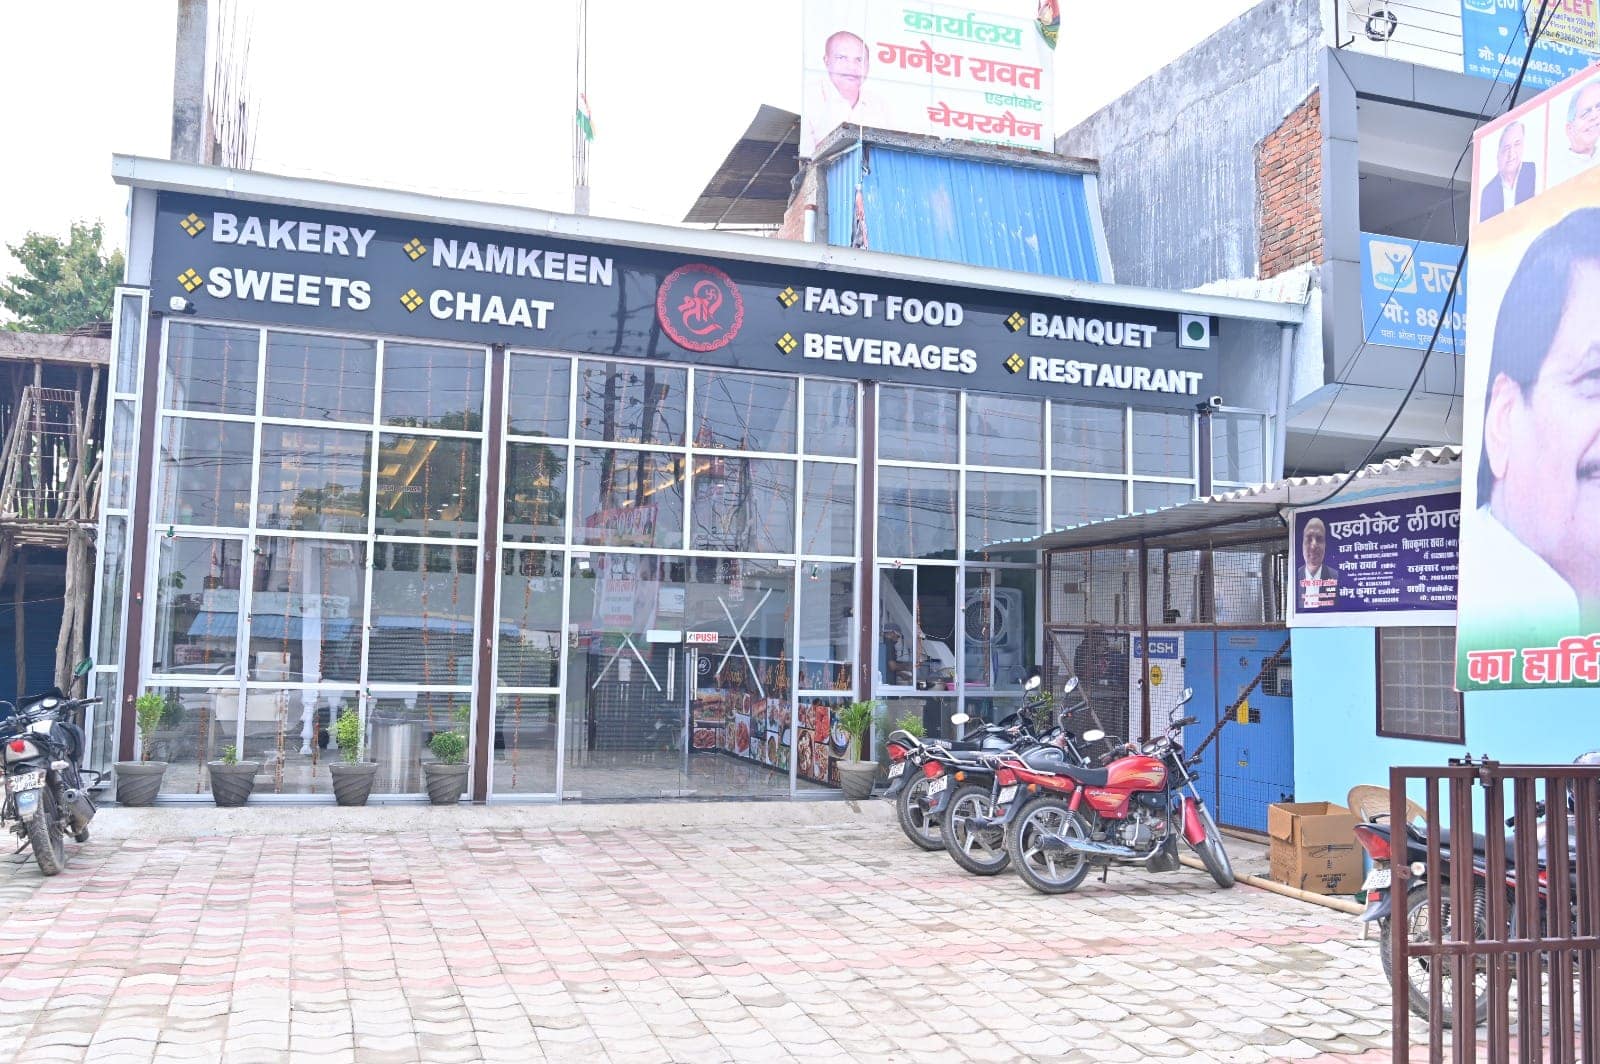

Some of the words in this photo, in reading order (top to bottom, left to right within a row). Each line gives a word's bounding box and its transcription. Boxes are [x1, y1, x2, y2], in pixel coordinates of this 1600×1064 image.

[903, 9, 1023, 46] कार्यालय
[876, 40, 963, 78] गनेश
[968, 57, 1043, 90] रावत
[927, 101, 1043, 140] चेयरमैन
[211, 212, 376, 258] BAKERY
[432, 238, 614, 286] NAMKEEN
[206, 266, 371, 311] SWEETS
[803, 285, 878, 319] FAST
[886, 295, 964, 328] FOOD
[429, 289, 555, 330] CHAAT
[1029, 313, 1157, 349] BANQUET
[803, 332, 978, 375] BEVERAGES
[1029, 355, 1203, 396] RESTAURANT
[1329, 511, 1401, 540] एडवोकेट
[695, 633, 717, 642] PUSH
[1467, 649, 1516, 684] का
